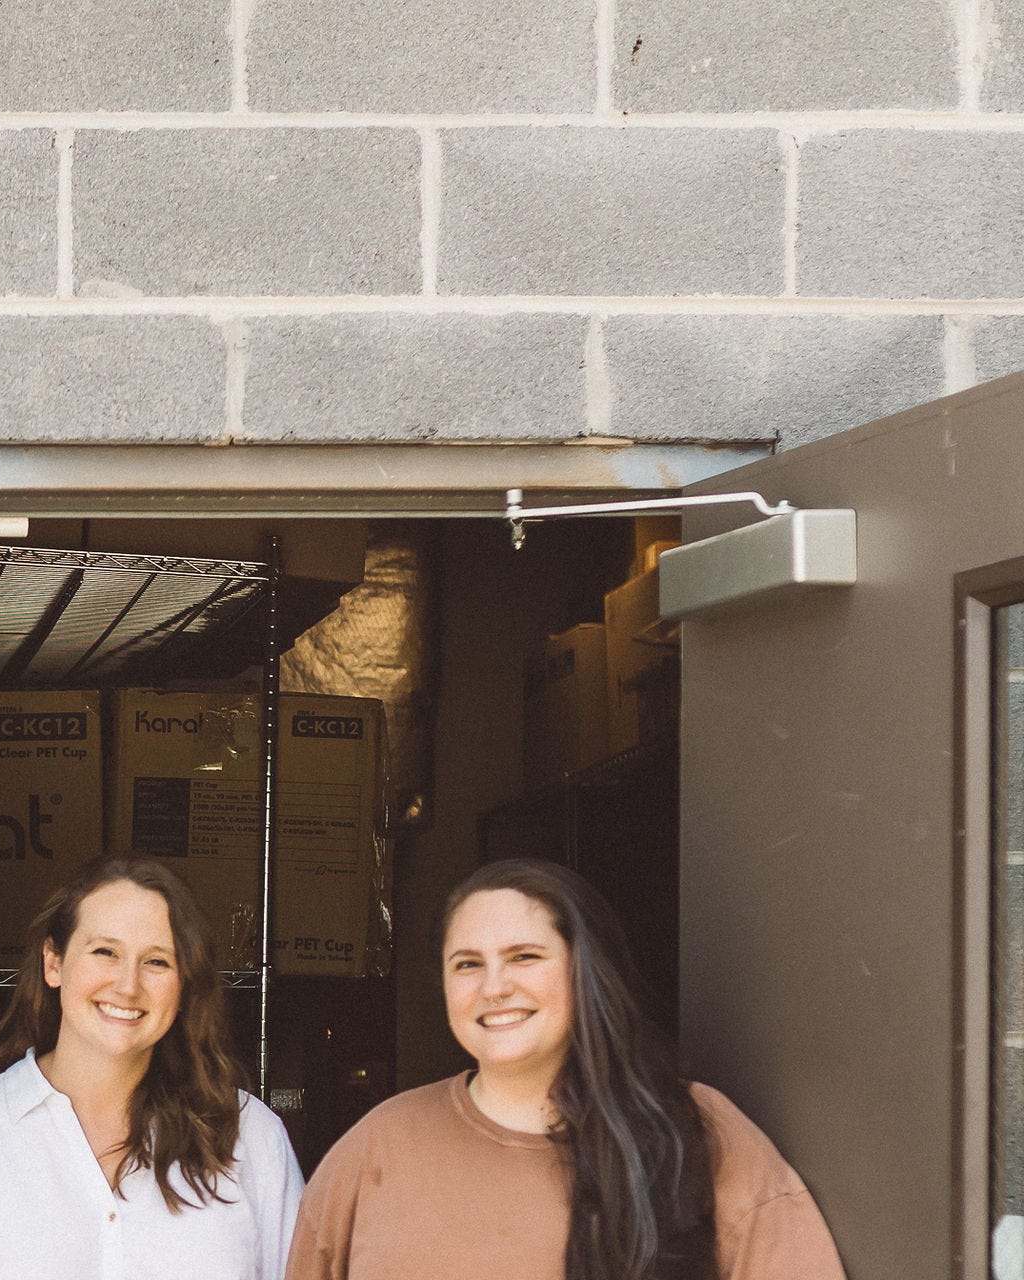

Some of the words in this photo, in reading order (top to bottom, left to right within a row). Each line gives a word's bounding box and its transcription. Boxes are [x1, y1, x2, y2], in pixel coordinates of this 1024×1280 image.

[0, 717, 81, 736] C-KC12
[296, 719, 359, 735] C-KC12
[36, 747, 58, 758] PET
[62, 746, 87, 760] Cup
[294, 937, 320, 950] PET
[324, 938, 354, 954] Cup
